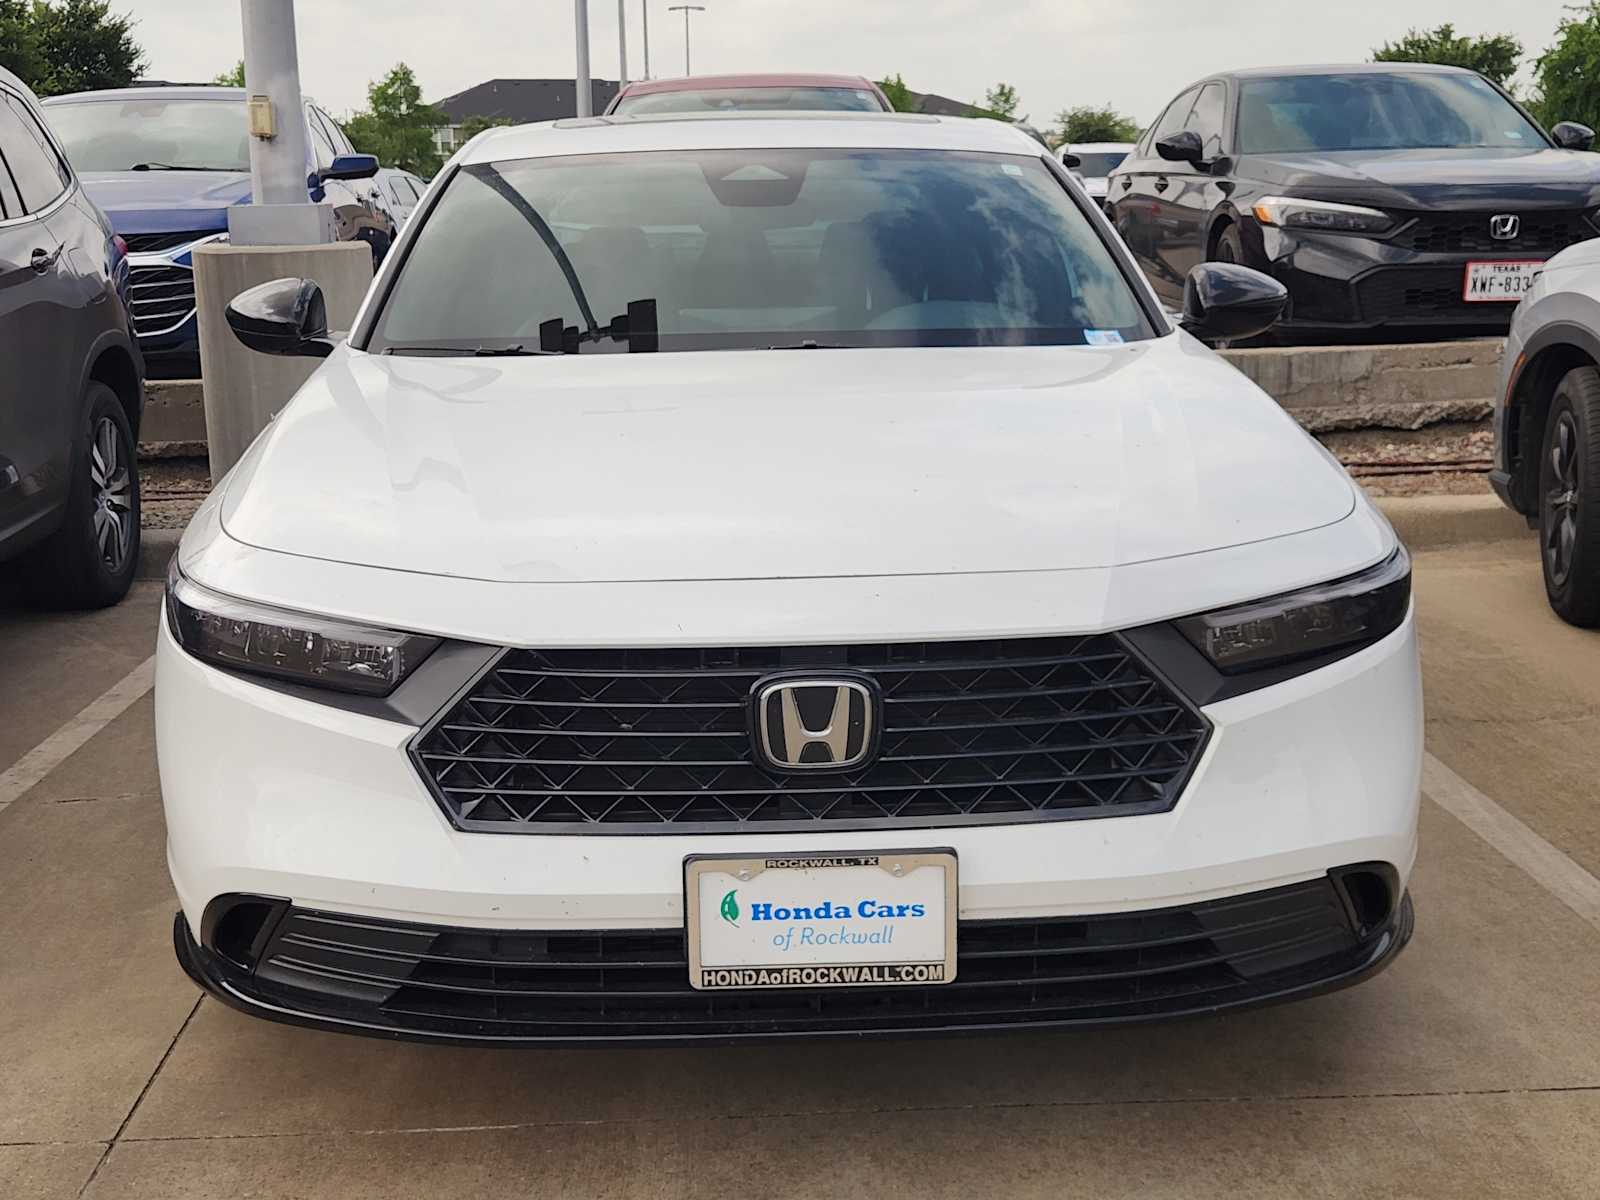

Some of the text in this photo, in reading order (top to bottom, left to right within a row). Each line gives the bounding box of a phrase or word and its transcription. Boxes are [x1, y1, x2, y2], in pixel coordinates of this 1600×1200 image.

[859, 858, 878, 866] TX
[751, 900, 925, 921] Honda Cars
[773, 926, 893, 951] of Rockwall
[704, 965, 943, 986] HONDAofROCKWALL.COM
